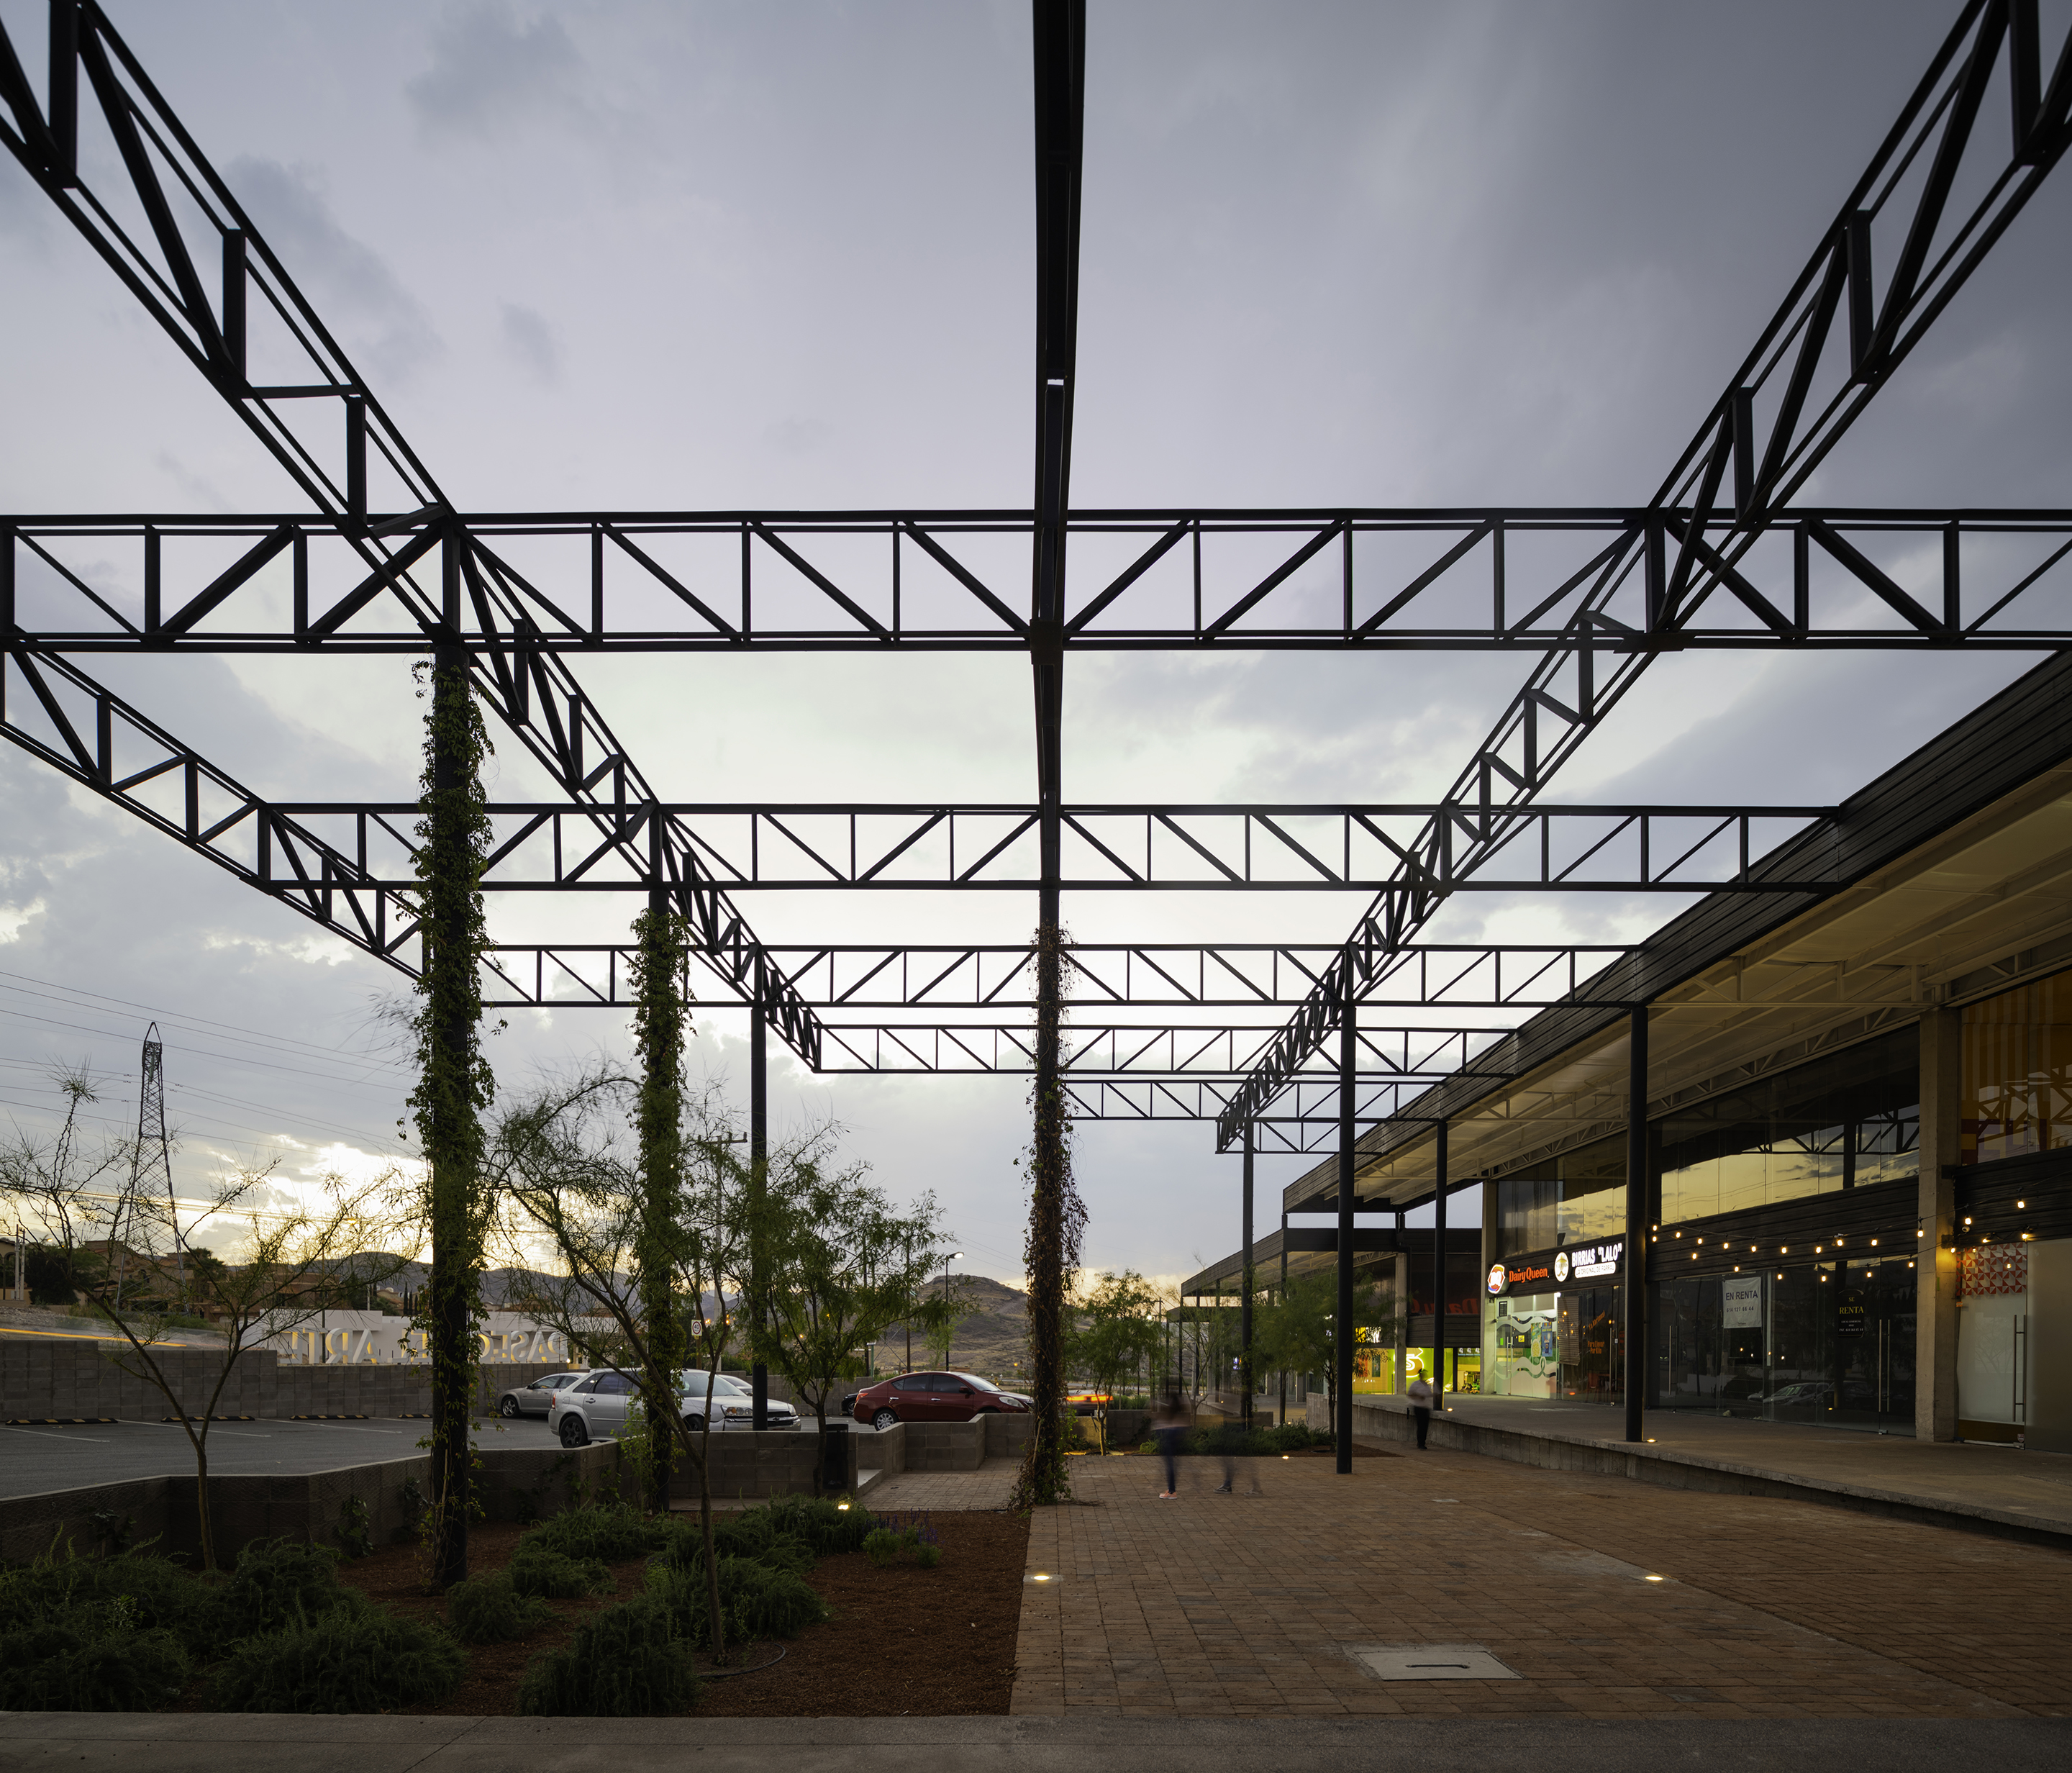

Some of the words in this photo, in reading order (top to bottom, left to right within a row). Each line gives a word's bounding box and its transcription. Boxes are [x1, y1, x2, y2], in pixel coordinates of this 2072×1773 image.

[1571, 1248, 1596, 1268] BIRRIAS
[1509, 1269, 1526, 1284] Dairy
[1725, 1292, 1734, 1301] EN
[1735, 1290, 1758, 1300] RENTA
[1839, 1306, 1864, 1315] RENTA
